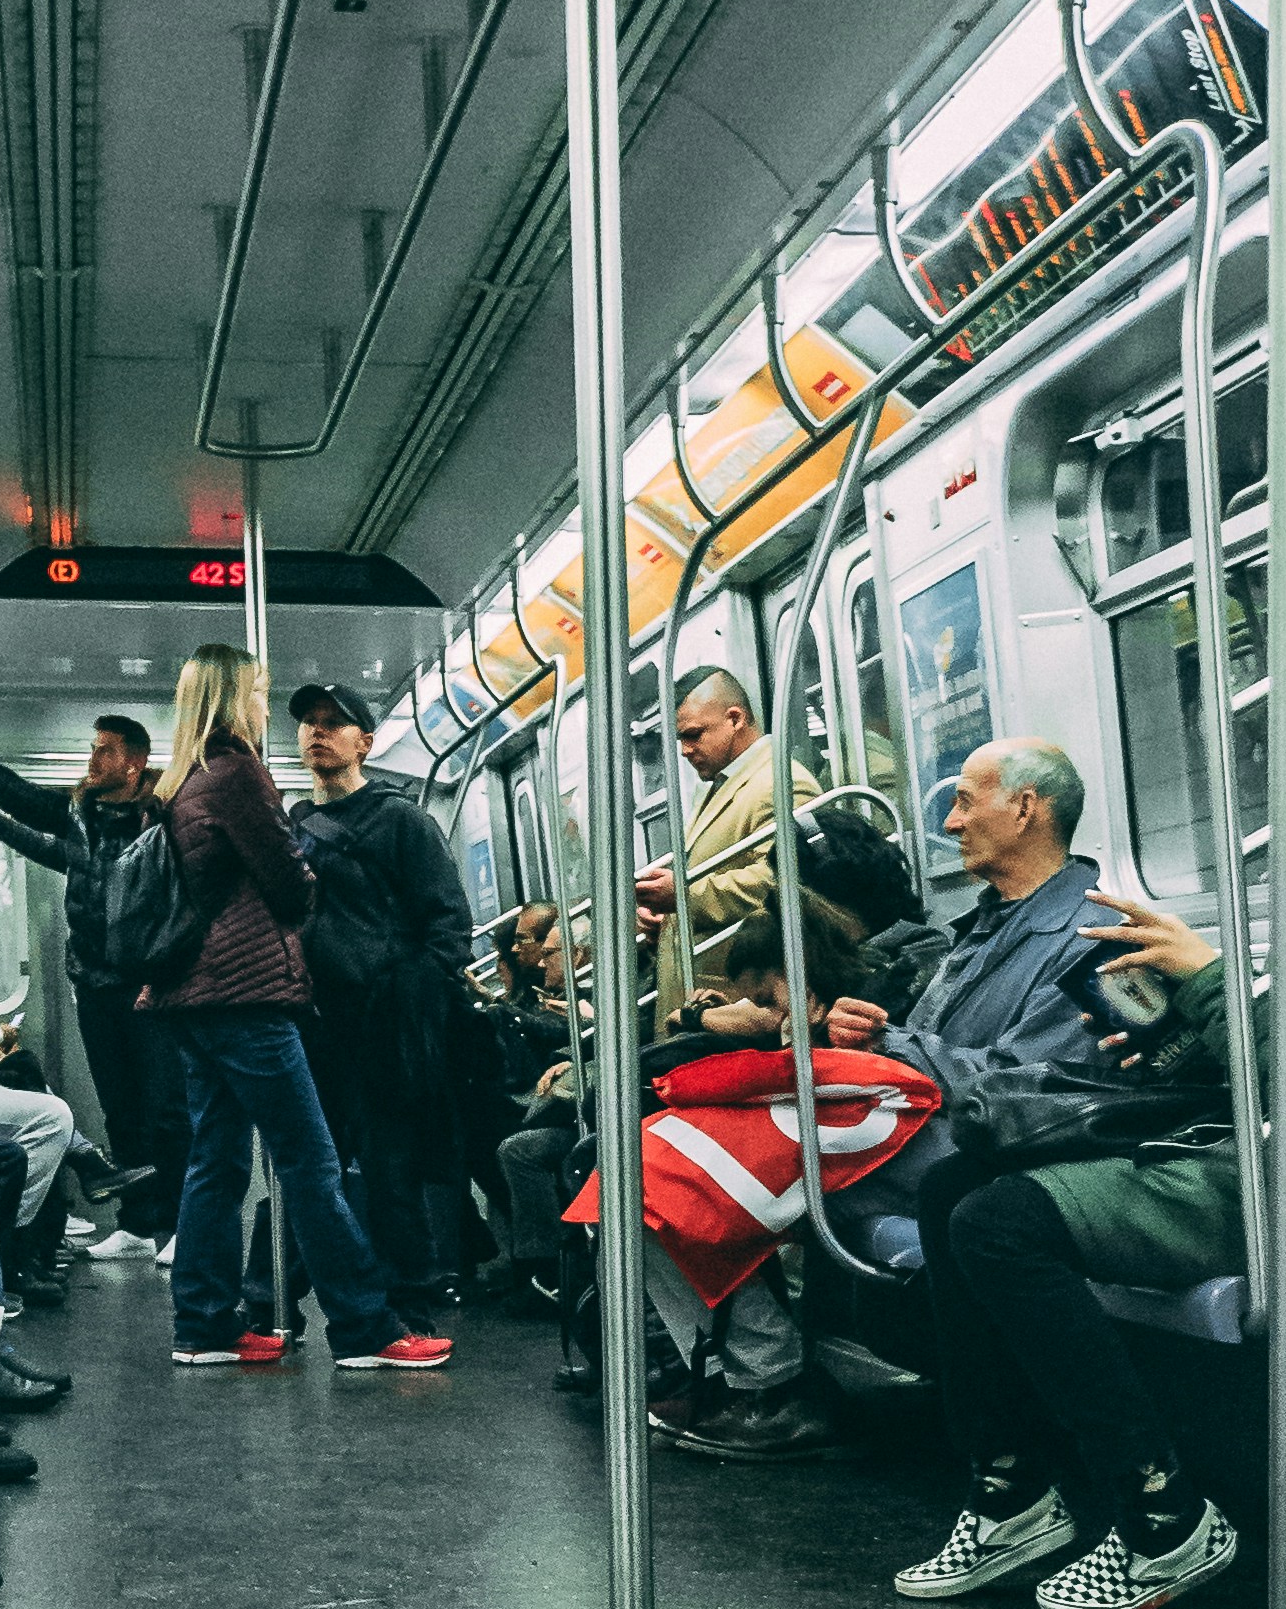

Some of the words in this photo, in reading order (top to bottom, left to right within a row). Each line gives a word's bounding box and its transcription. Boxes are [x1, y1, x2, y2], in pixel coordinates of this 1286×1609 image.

[1181, 29, 1209, 71] Stop
[189, 561, 225, 586] 42
[228, 561, 246, 586] S
